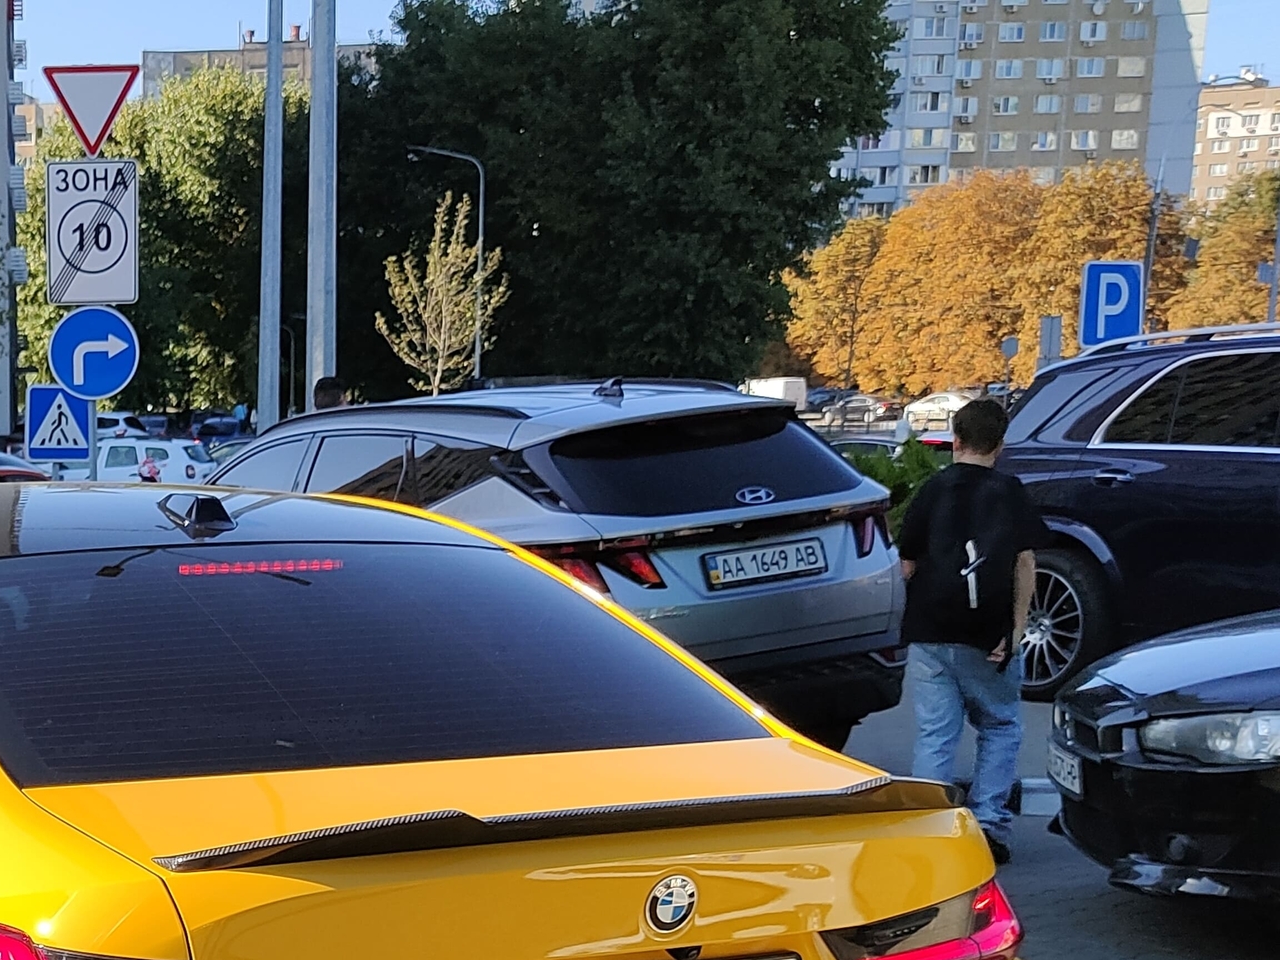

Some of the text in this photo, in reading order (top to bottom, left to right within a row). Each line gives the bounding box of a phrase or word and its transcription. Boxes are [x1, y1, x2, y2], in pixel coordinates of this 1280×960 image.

[55, 167, 128, 192] ЗОНА
[71, 222, 112, 252] 10
[1096, 272, 1129, 339] P
[721, 545, 819, 580] AA 1649 AB
[654, 878, 695, 897] BMW
